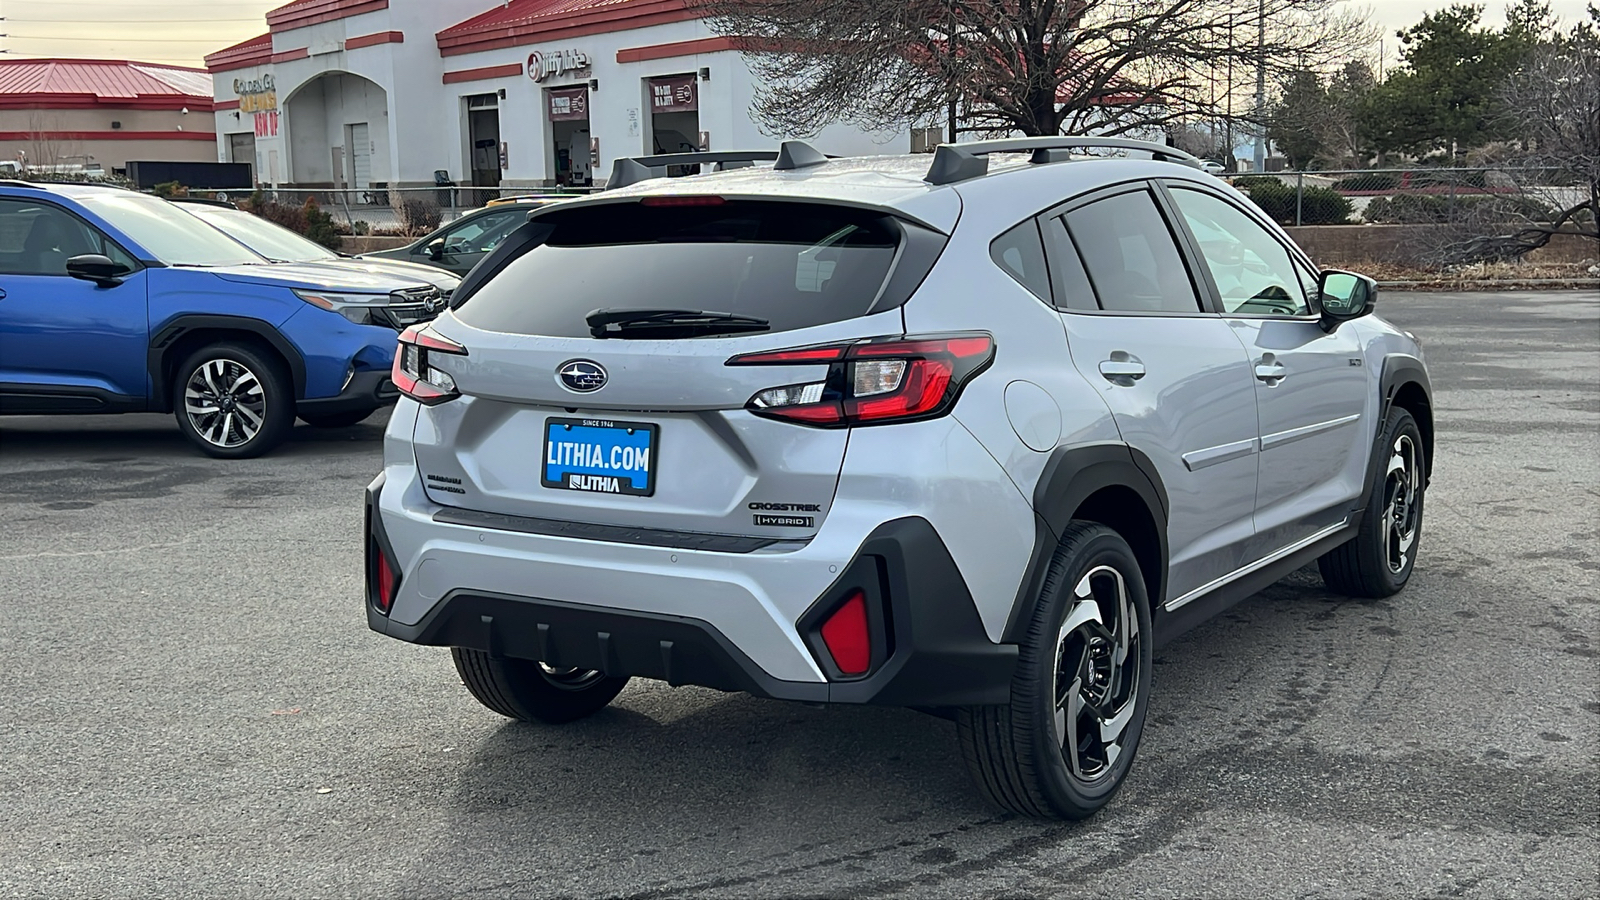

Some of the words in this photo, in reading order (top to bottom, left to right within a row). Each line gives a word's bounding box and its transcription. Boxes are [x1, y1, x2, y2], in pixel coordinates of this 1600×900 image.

[547, 440, 650, 472] LITHIA.COM
[580, 475, 620, 493] LITHIA
[748, 502, 821, 512] CROSSTREK
